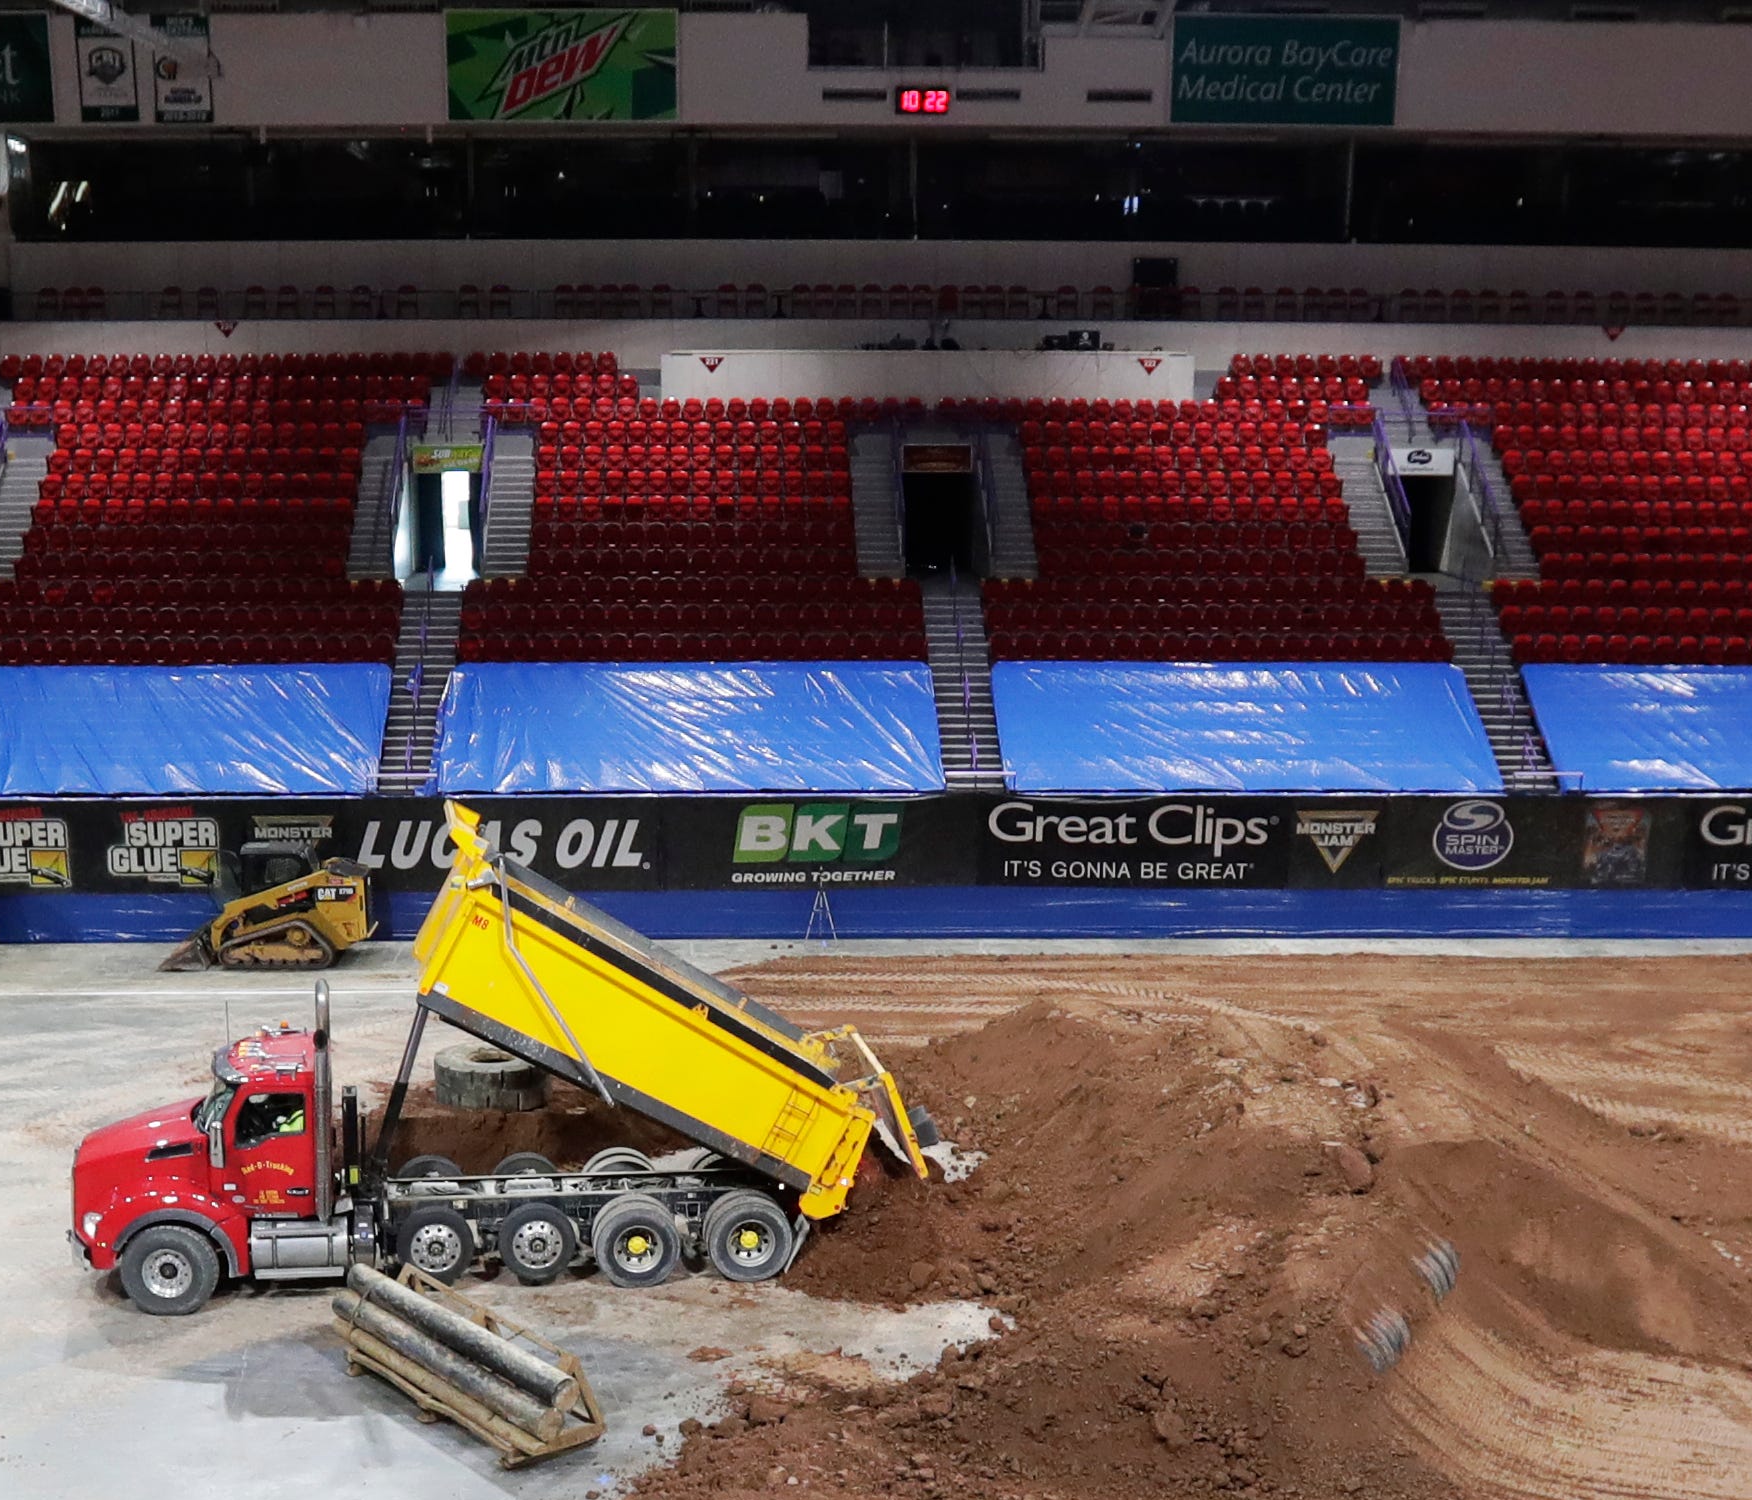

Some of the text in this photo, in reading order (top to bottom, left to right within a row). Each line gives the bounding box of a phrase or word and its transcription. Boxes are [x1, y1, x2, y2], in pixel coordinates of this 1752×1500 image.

[1179, 37, 1393, 73] Aurora BayCare
[1178, 74, 1382, 102] Medical Center
[129, 821, 215, 847] SUPER
[254, 826, 332, 839] MONSTER
[738, 813, 899, 852] BKT
[988, 802, 1268, 857] Great Clips
[1296, 822, 1375, 835] MONSTER
[1318, 835, 1354, 847] JAM
[1445, 834, 1499, 846] SPIN
[1445, 844, 1498, 855] MASTER
[111, 848, 178, 873] GLUE
[1004, 860, 1246, 880] IT'S GONNA BE GREAT
[732, 870, 895, 884] GROWING TOGETHER
[1712, 863, 1750, 882] IT'S
[317, 887, 336, 900] CAT
